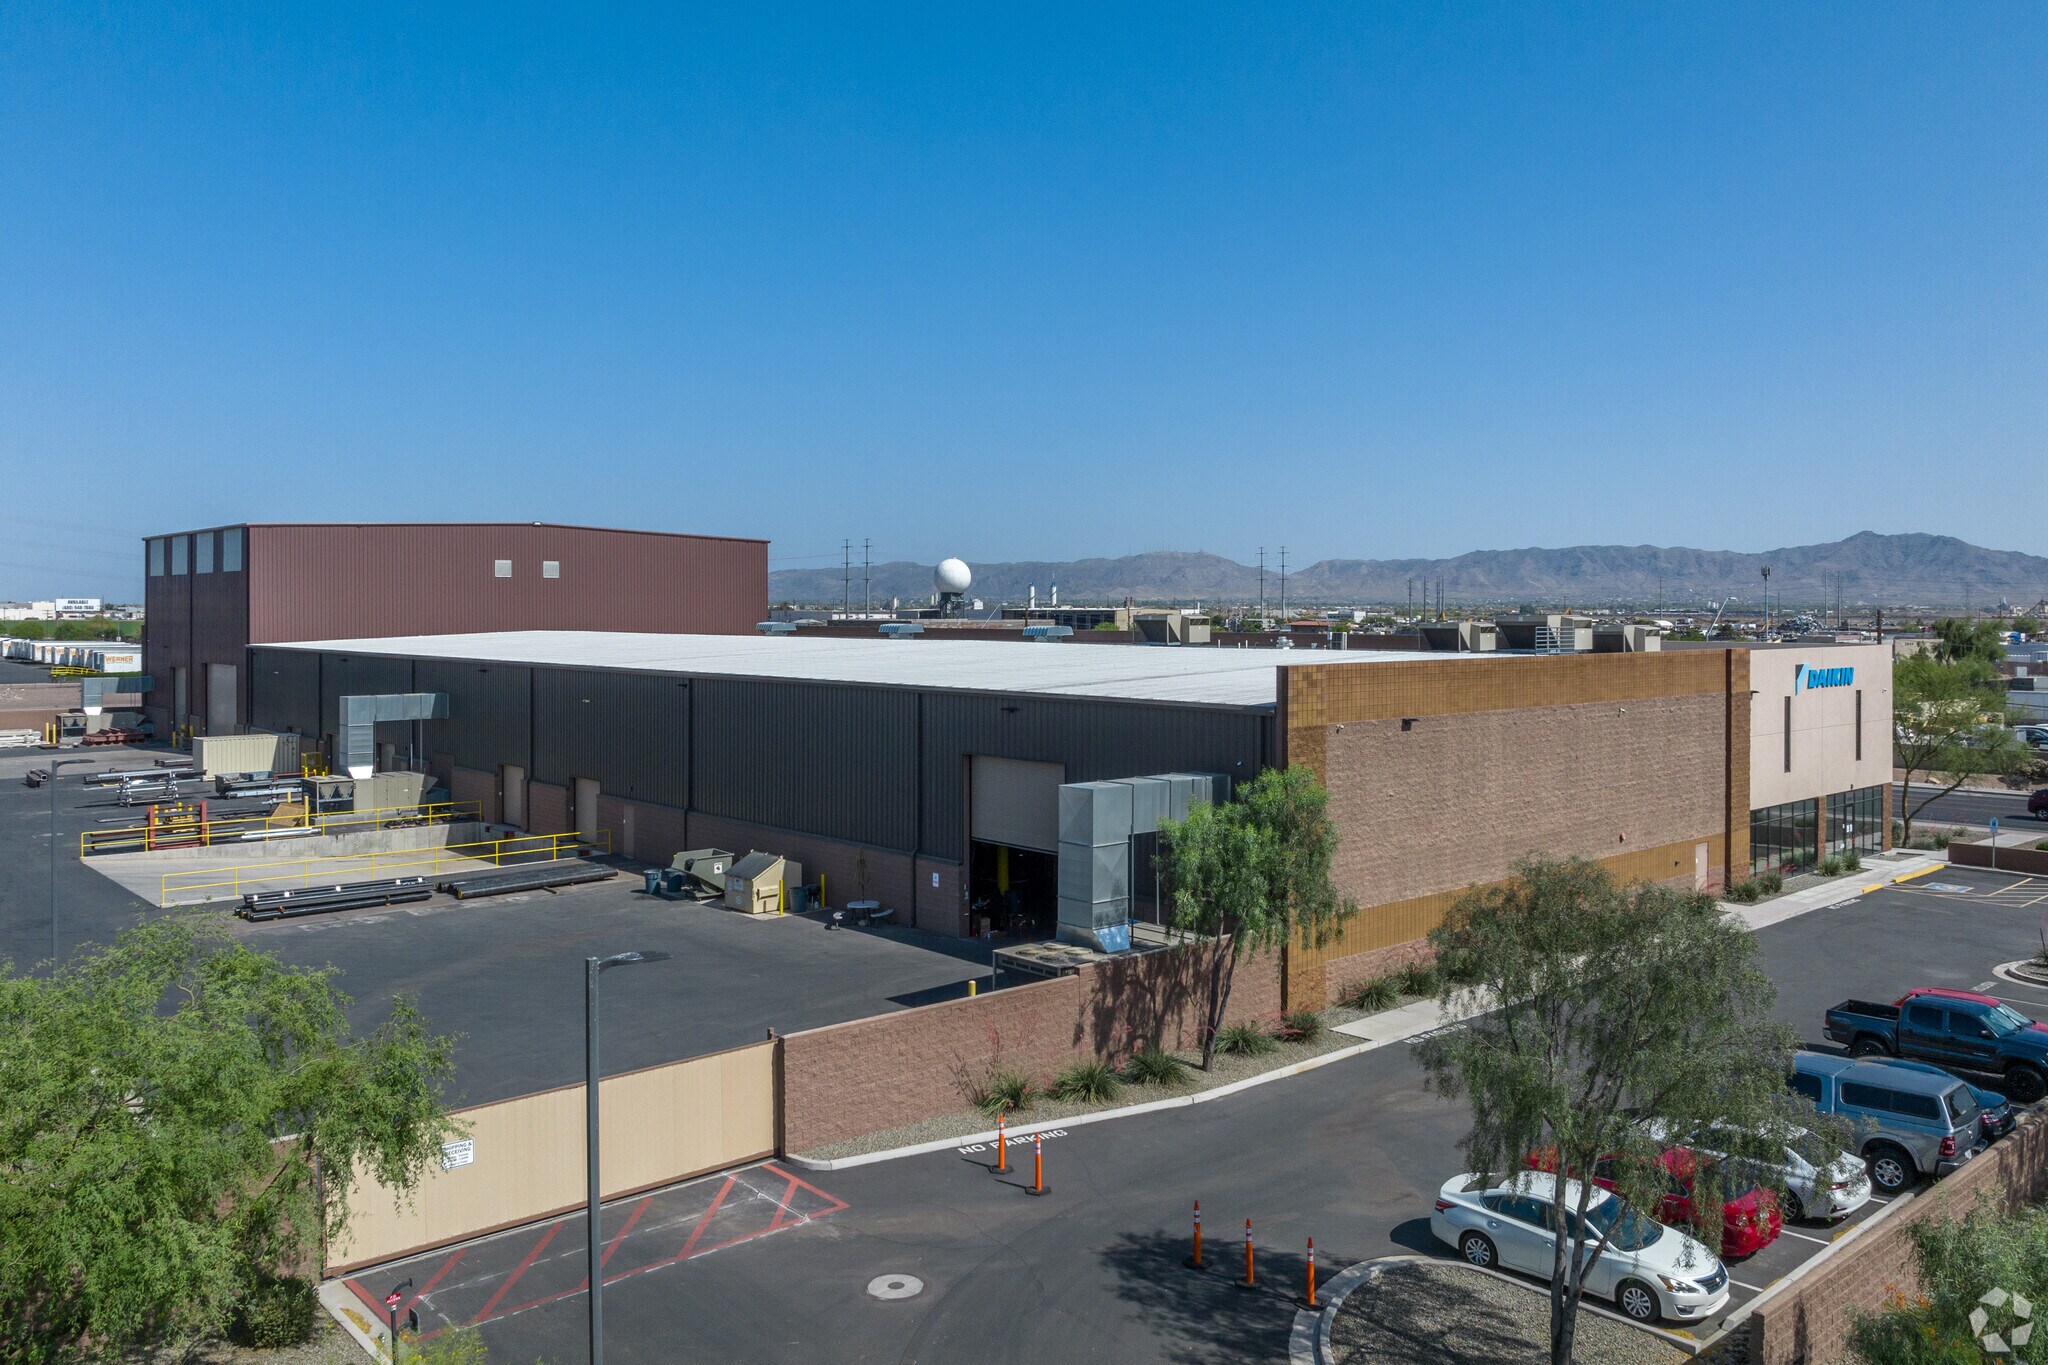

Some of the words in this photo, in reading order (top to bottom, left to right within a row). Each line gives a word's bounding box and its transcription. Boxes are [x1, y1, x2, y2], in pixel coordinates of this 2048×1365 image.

[1807, 667, 1854, 689] DAIKIN
[444, 1147, 471, 1155] ECEIVING
[957, 1144, 987, 1155] NO
